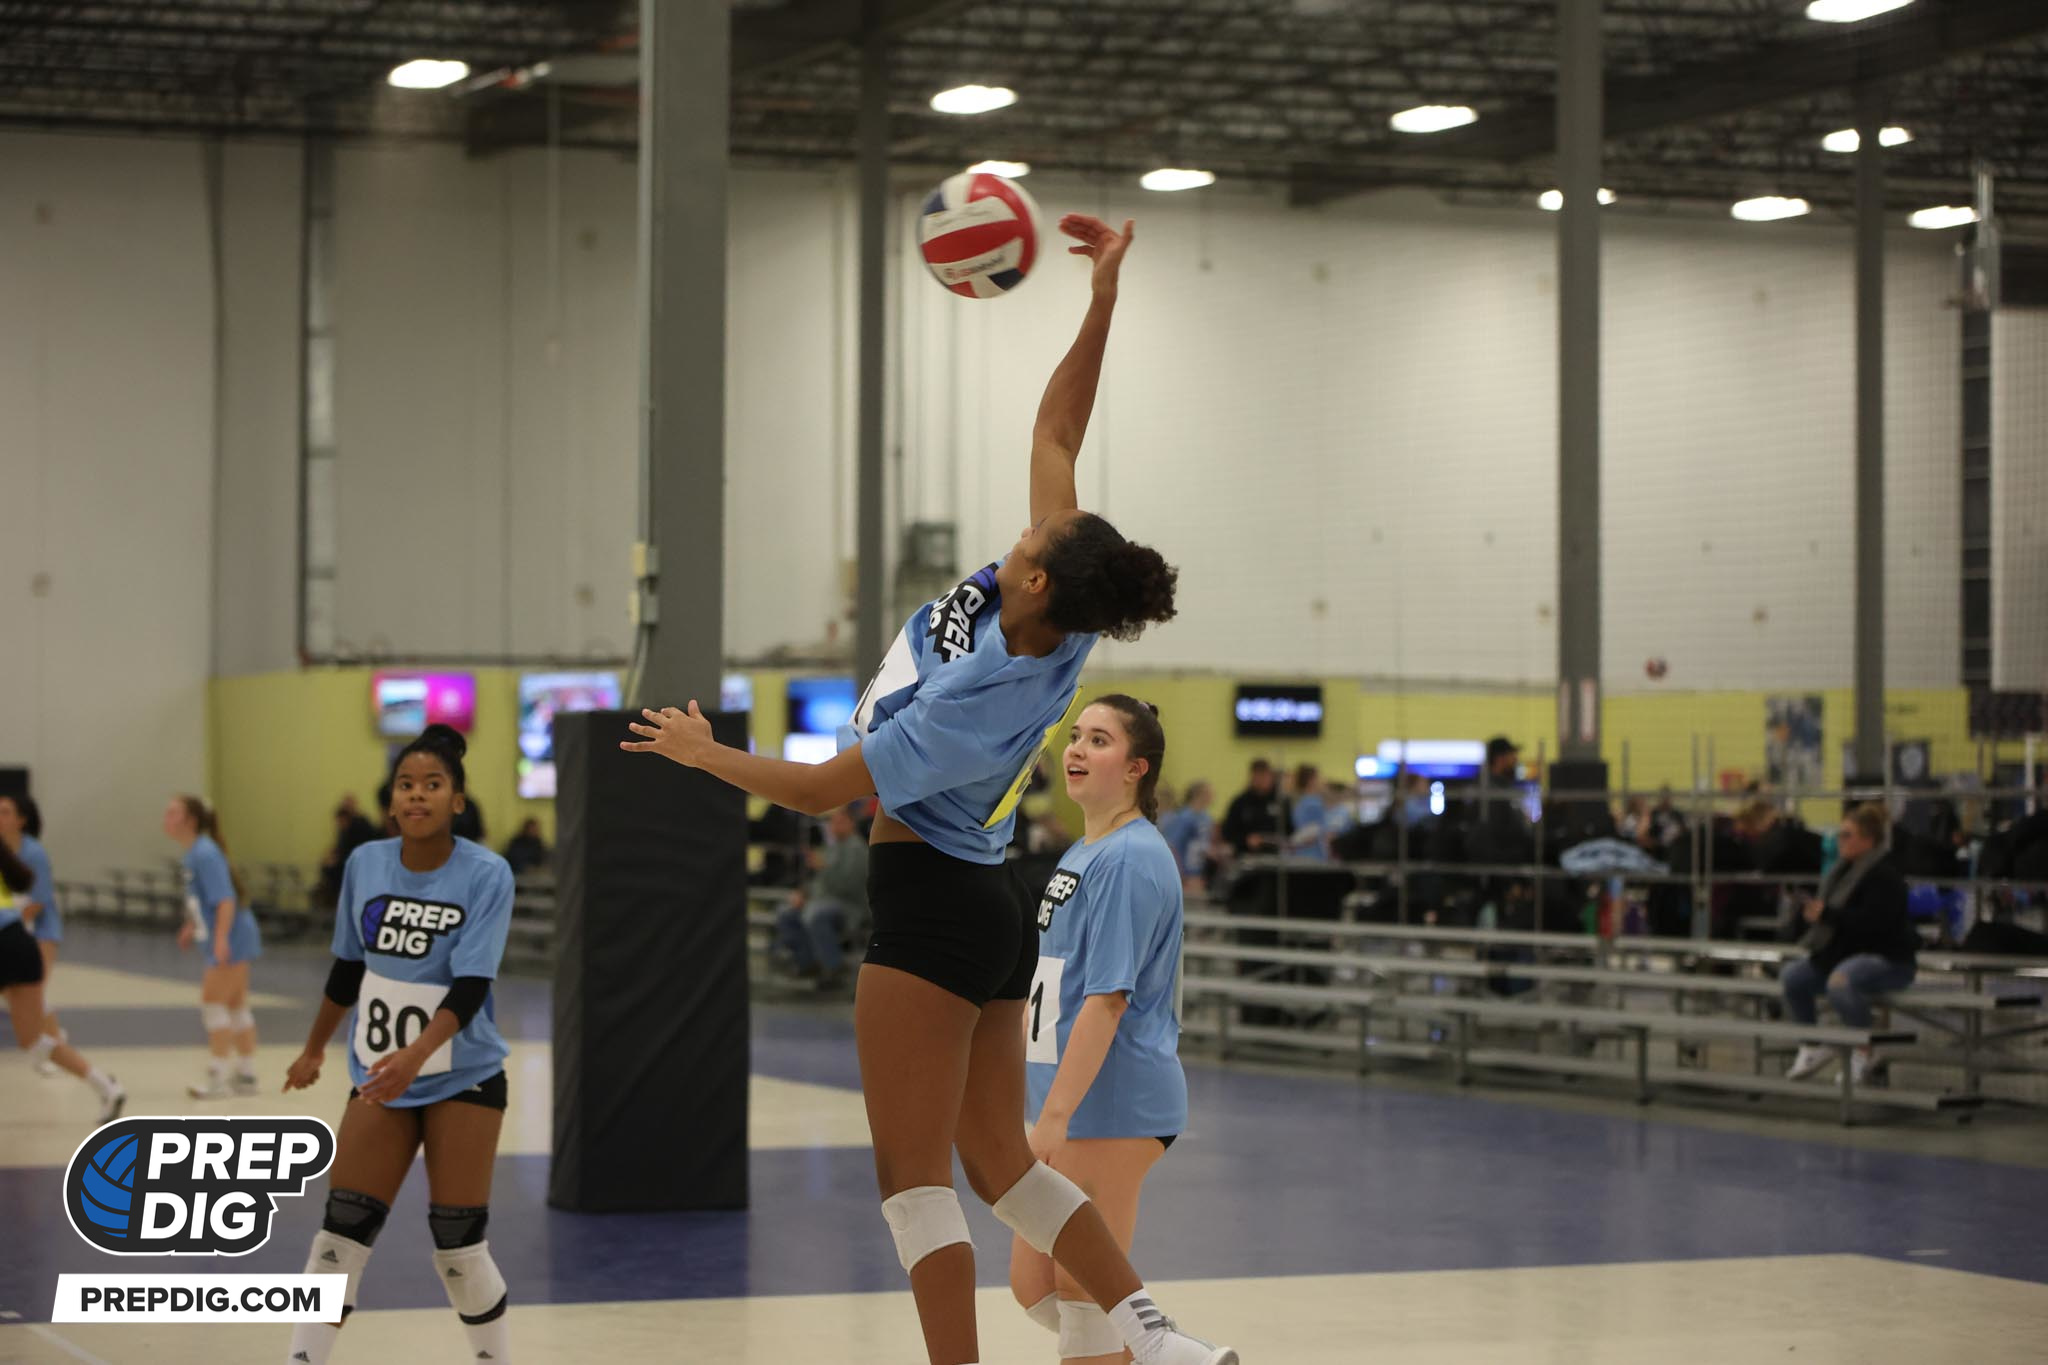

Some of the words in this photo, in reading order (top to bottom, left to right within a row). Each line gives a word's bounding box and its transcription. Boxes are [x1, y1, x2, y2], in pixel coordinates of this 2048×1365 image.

[384, 900, 461, 931] PREP
[377, 926, 428, 955] DIG
[366, 998, 432, 1053] 80
